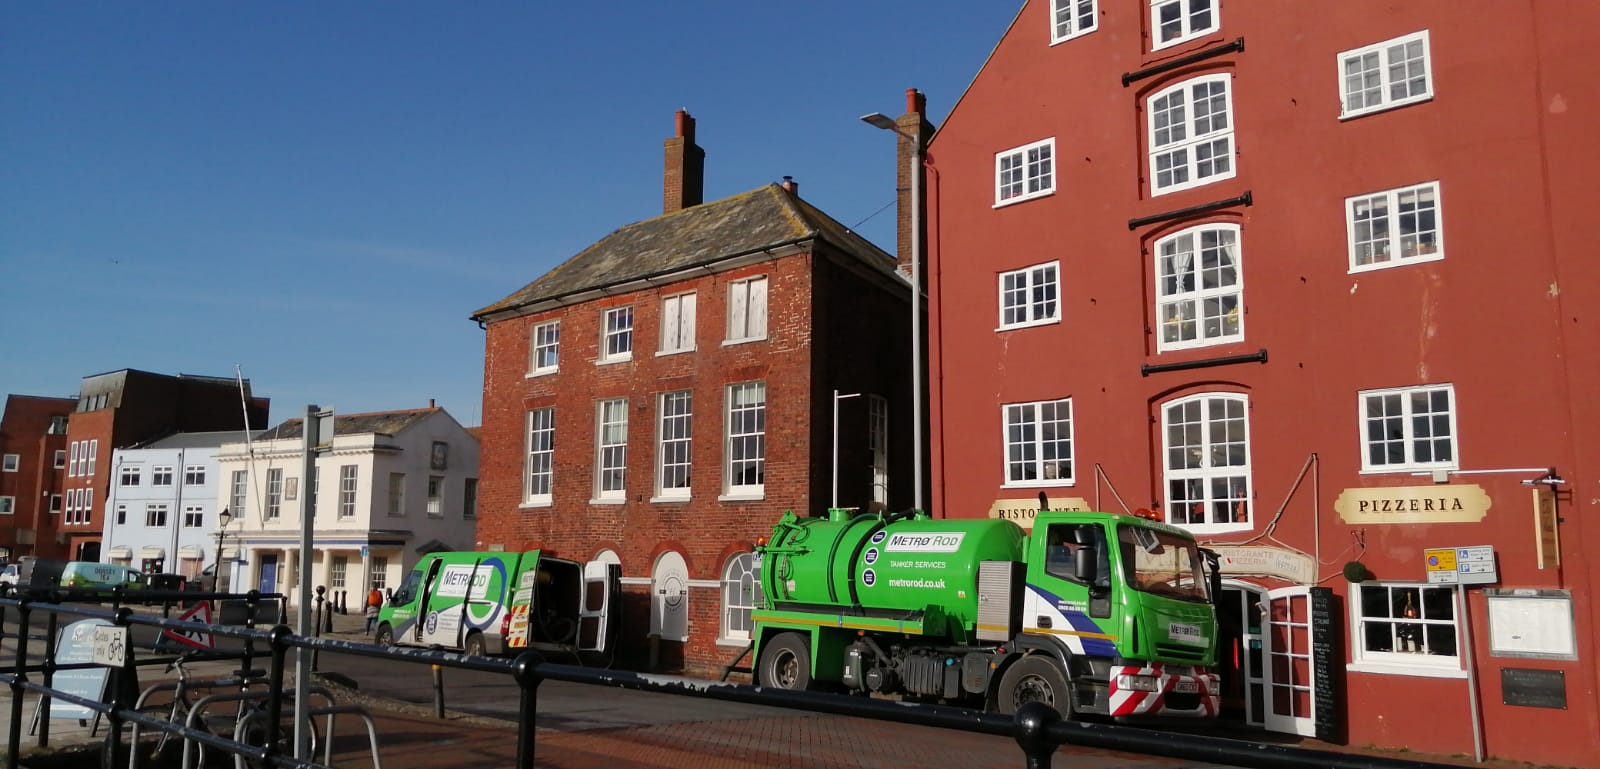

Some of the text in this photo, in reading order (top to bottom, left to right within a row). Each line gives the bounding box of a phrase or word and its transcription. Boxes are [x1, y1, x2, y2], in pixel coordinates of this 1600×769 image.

[1358, 497, 1464, 513] PIZZERIA
[889, 560, 947, 569] TANKER SERVICES
[888, 578, 946, 589] metrorod.co.uk
